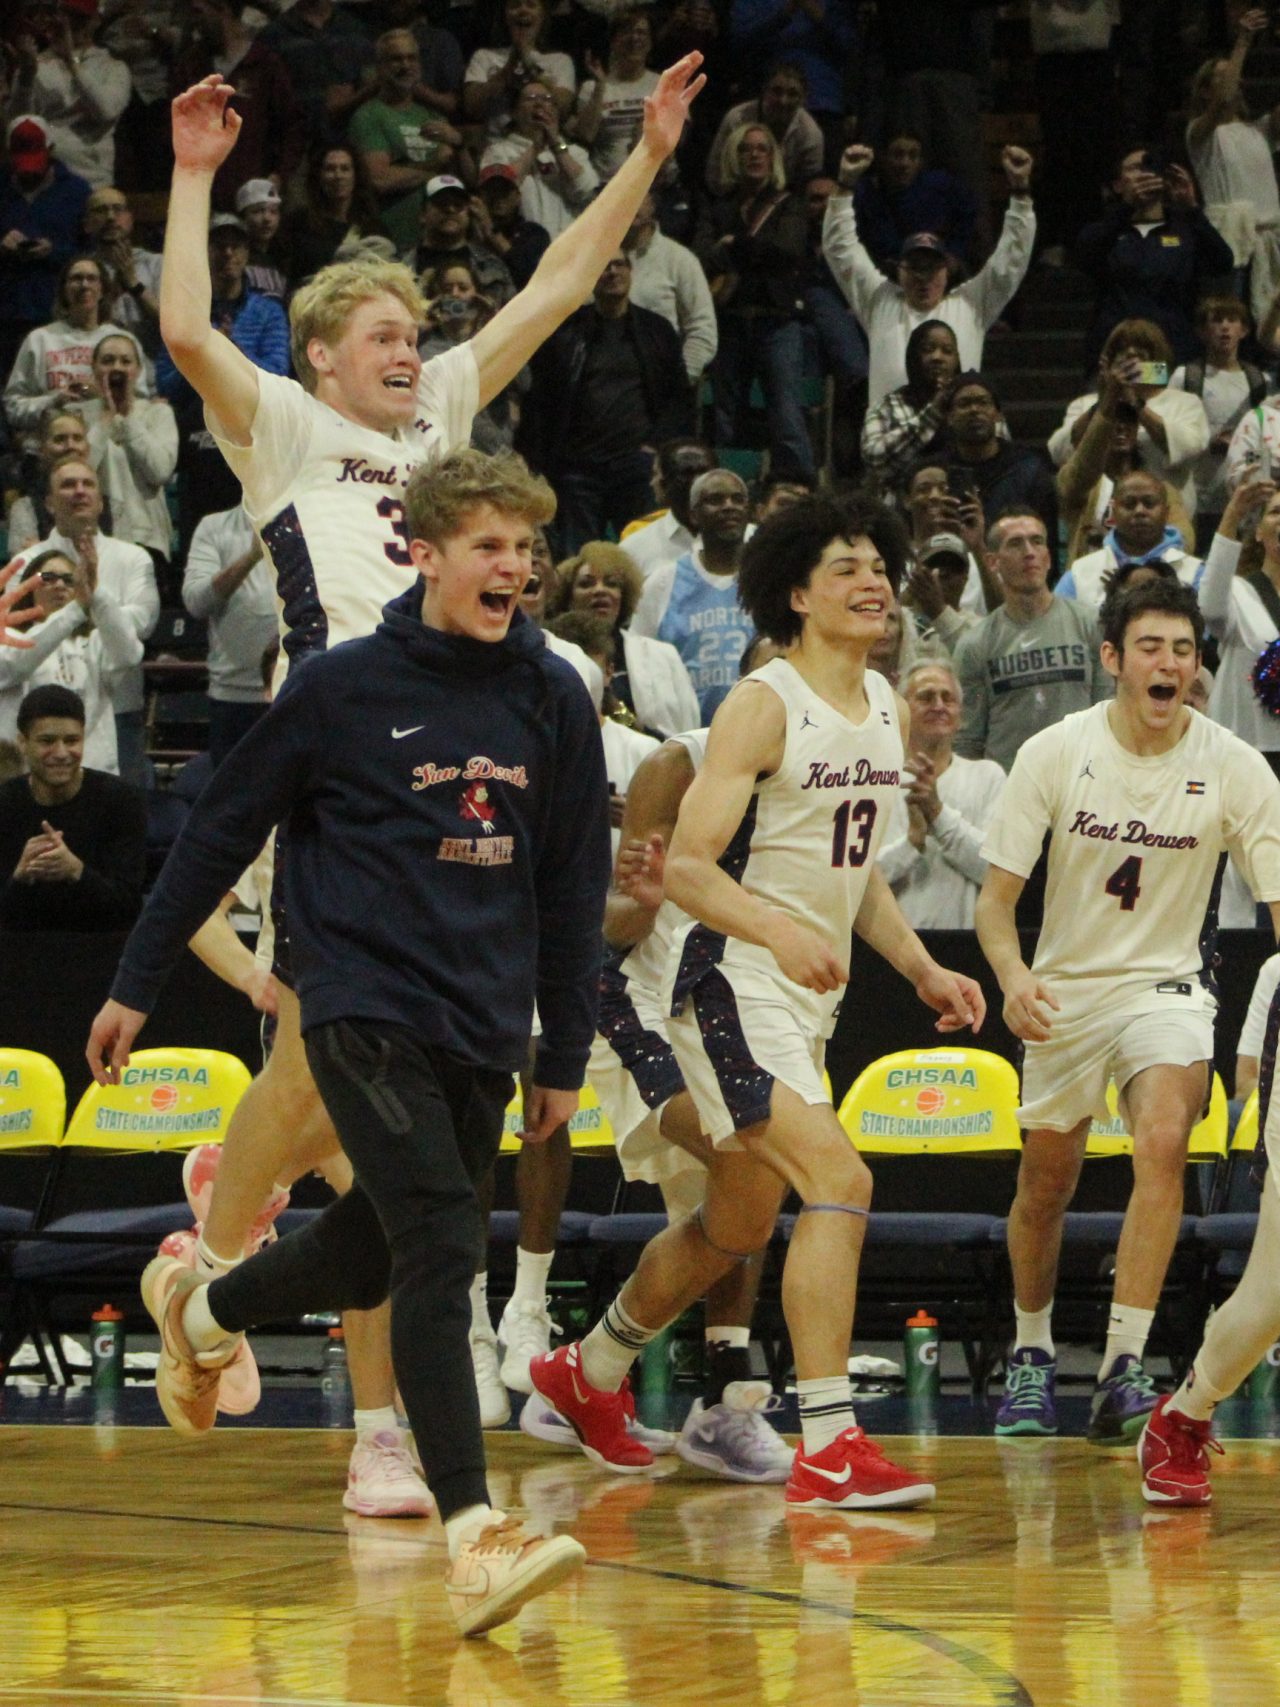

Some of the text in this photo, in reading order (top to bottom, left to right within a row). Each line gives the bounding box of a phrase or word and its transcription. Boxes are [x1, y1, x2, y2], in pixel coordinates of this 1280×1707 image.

[336, 458, 398, 486] Kent
[689, 606, 756, 633] NORTH
[699, 629, 748, 663] 23
[986, 643, 1086, 679] NUGGETS
[411, 755, 529, 791] Sun Devils
[801, 758, 900, 790] Kent Denver
[831, 799, 878, 868] 13
[1068, 810, 1199, 850] Kent Denver
[1105, 855, 1143, 912] 4
[123, 1068, 208, 1086] CHSAA
[887, 1069, 977, 1089] CHSAA
[97, 1107, 221, 1132] STATE CHAMPIONSHIPS
[861, 1110, 993, 1136] STATE CHAMPIONSHIPS
[94, 1334, 115, 1358] G
[920, 1341, 938, 1366] G
